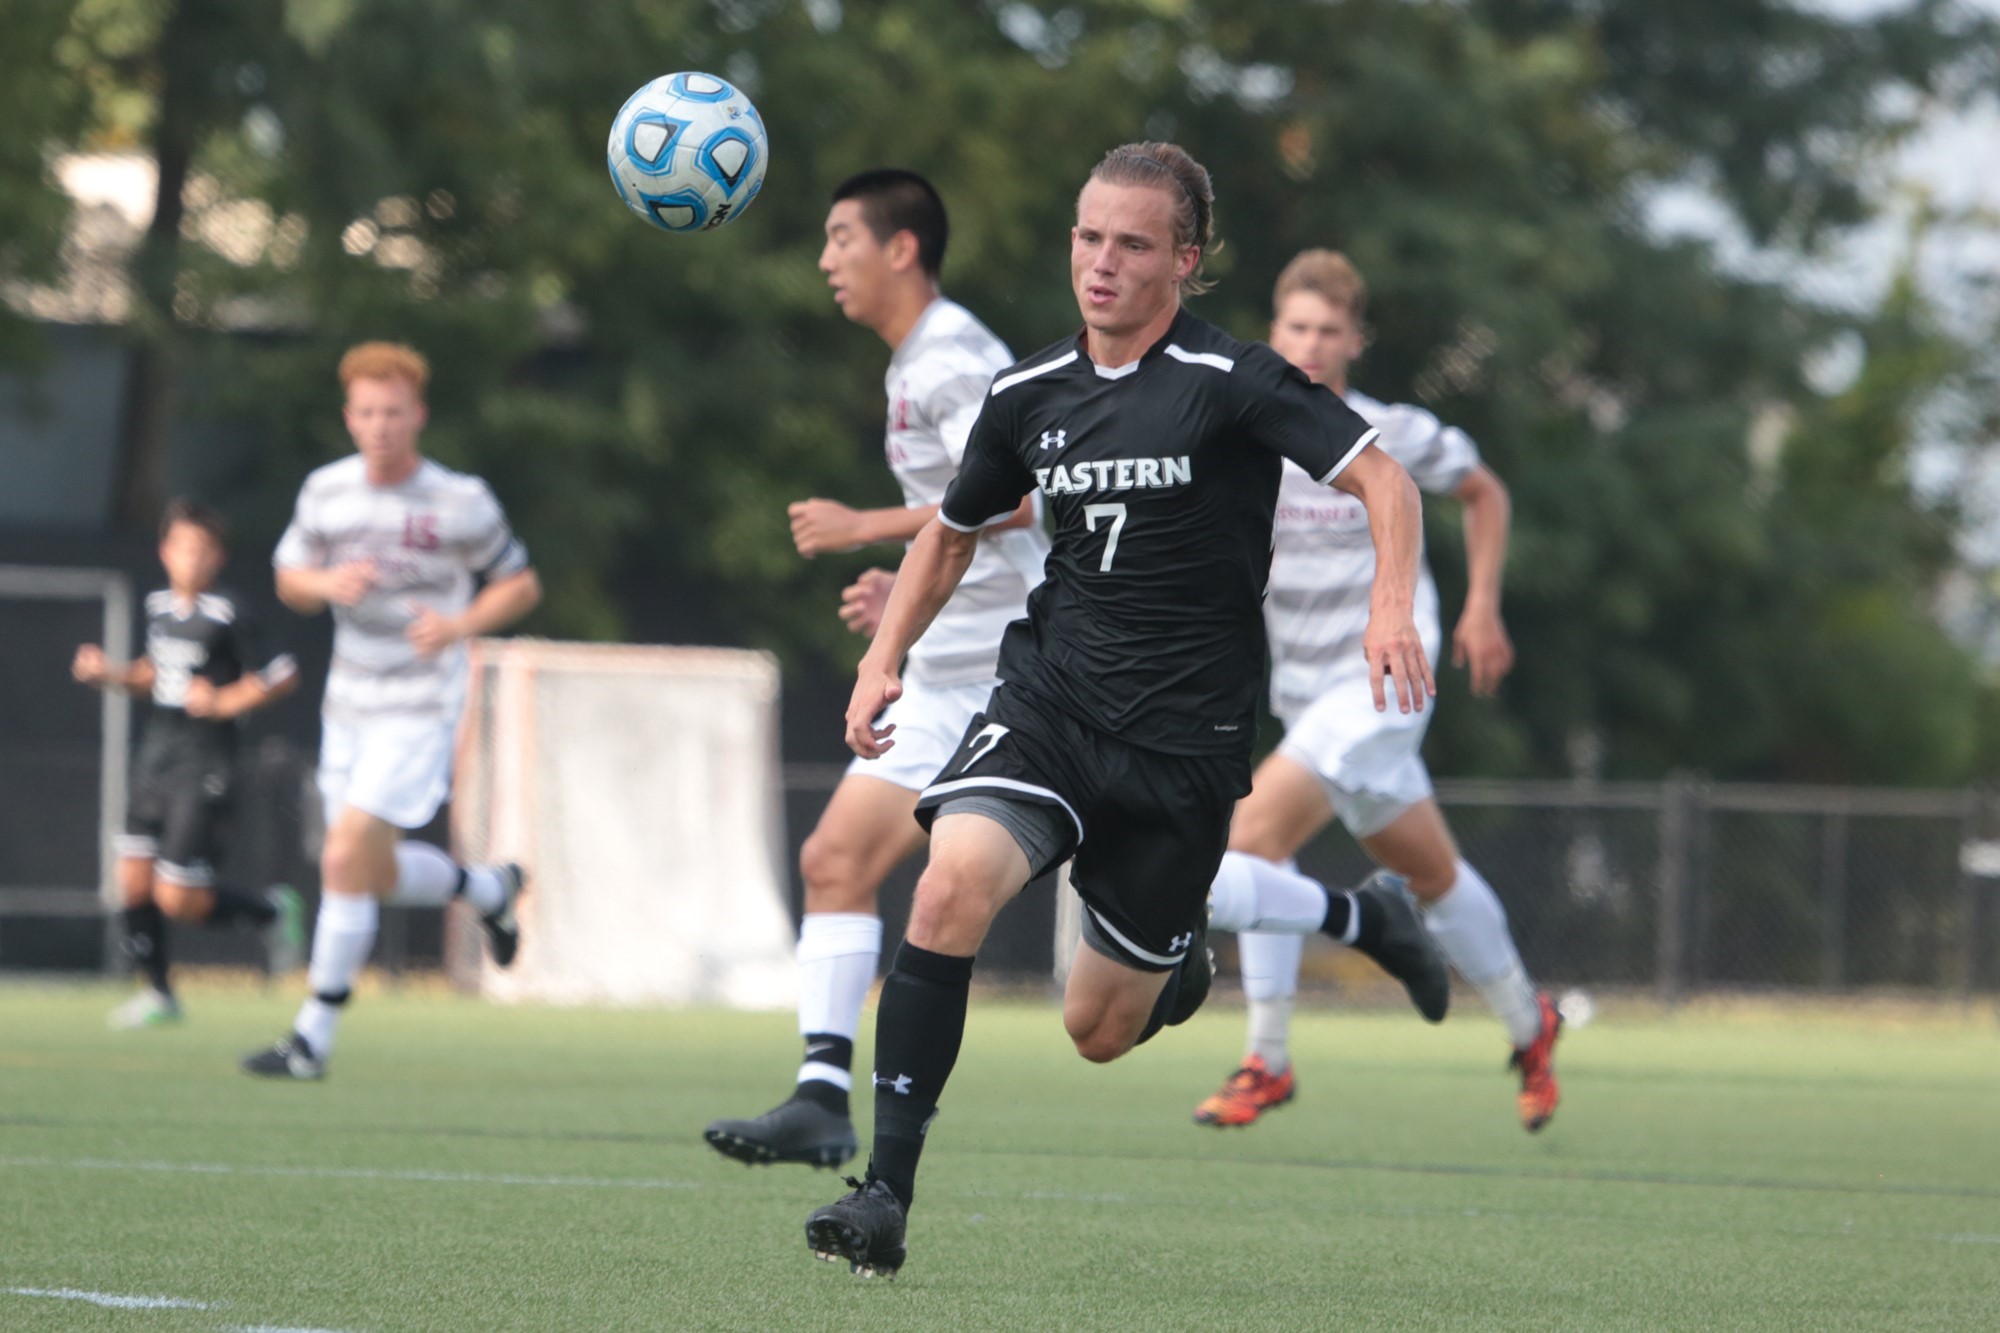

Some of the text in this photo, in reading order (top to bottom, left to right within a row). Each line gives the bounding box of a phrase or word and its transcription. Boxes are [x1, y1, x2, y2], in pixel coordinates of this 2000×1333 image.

[1033, 455, 1192, 497] EASTERN
[1083, 502, 1127, 572] 7
[960, 723, 1010, 774] 7
